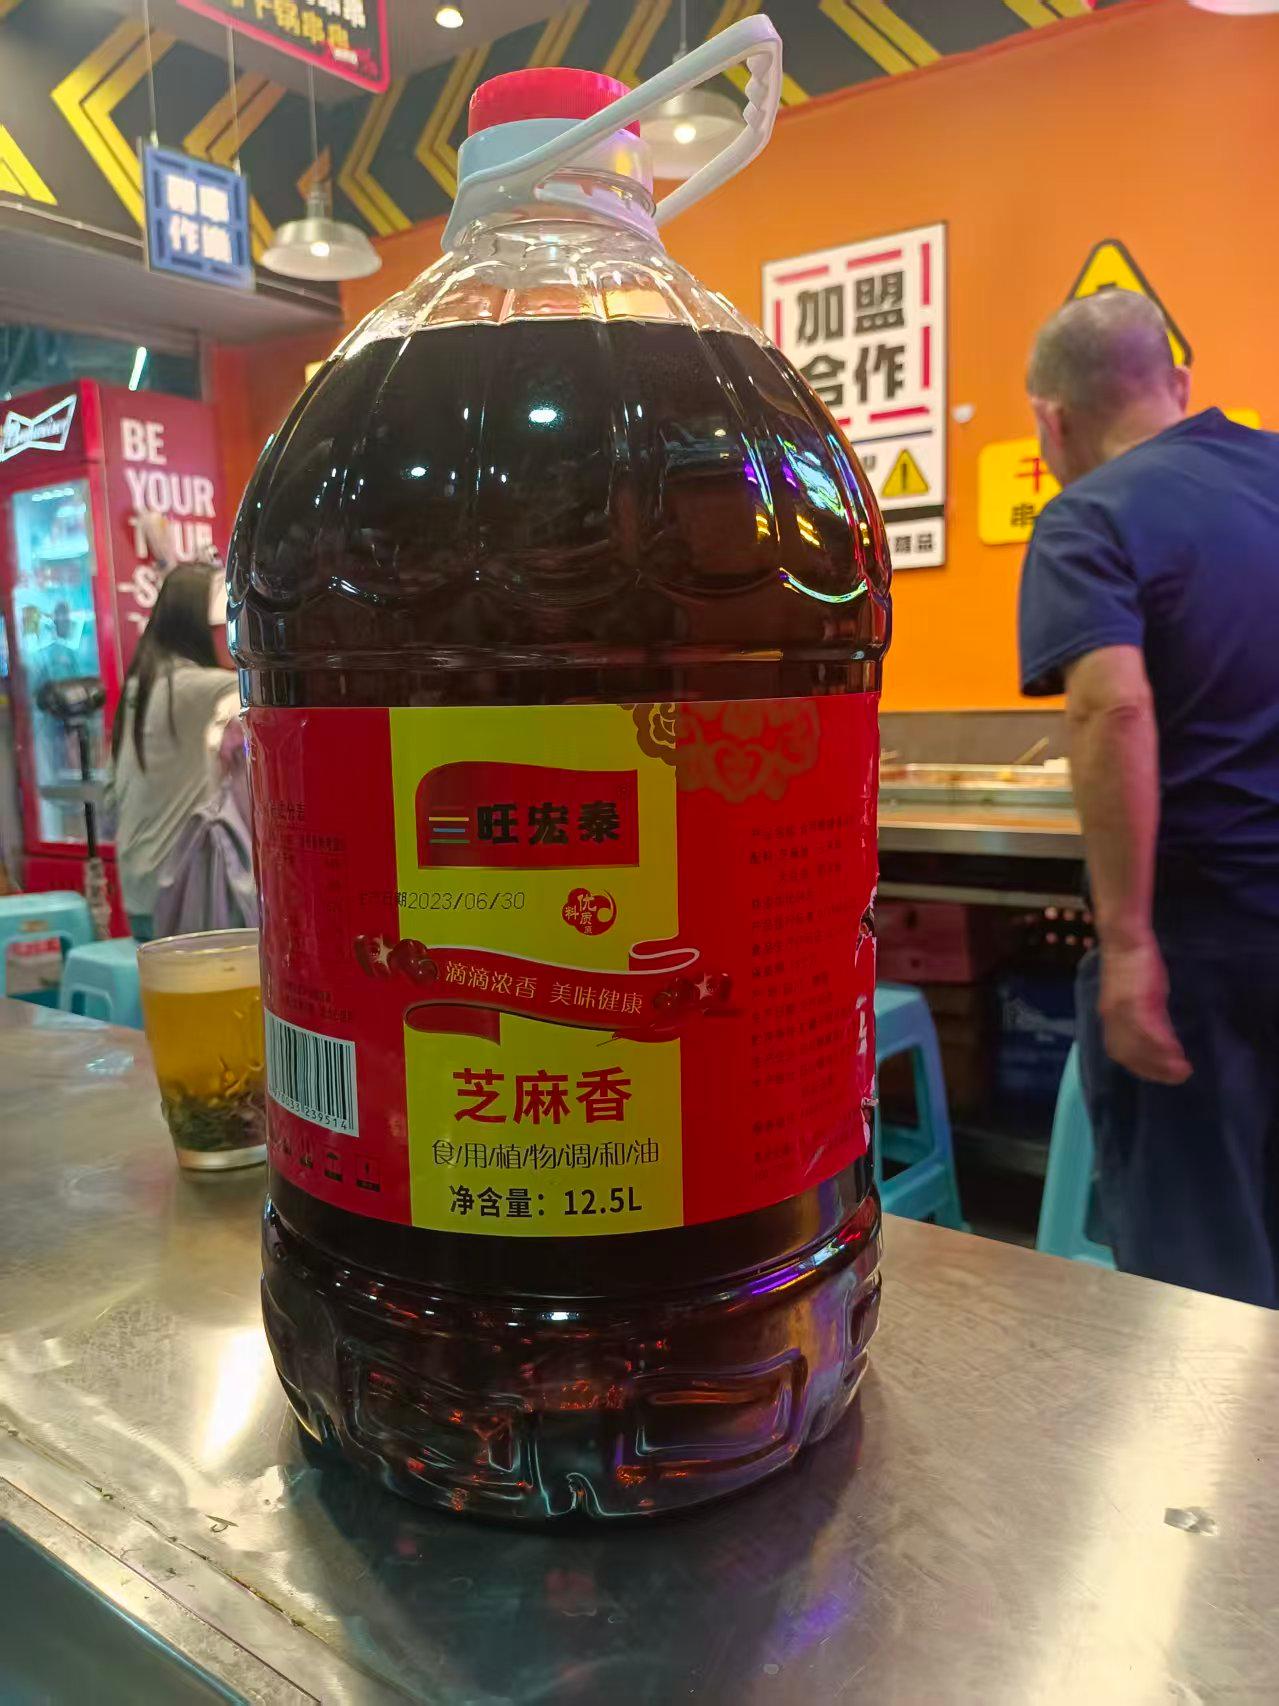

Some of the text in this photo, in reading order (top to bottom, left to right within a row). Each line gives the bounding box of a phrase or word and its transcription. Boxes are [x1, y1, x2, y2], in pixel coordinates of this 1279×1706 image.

[797, 270, 905, 345] 加盟
[800, 343, 906, 407] 合作
[122, 418, 167, 465] BE
[125, 467, 216, 518] YOUR
[476, 800, 621, 846] 旺宏泰
[445, 960, 643, 1015] 滴滴浓香 美味健康
[304, 1105, 348, 1130] 239514
[453, 1066, 632, 1125] 芝麻香
[431, 1138, 660, 1170] 食/用/植/物/调/和/油
